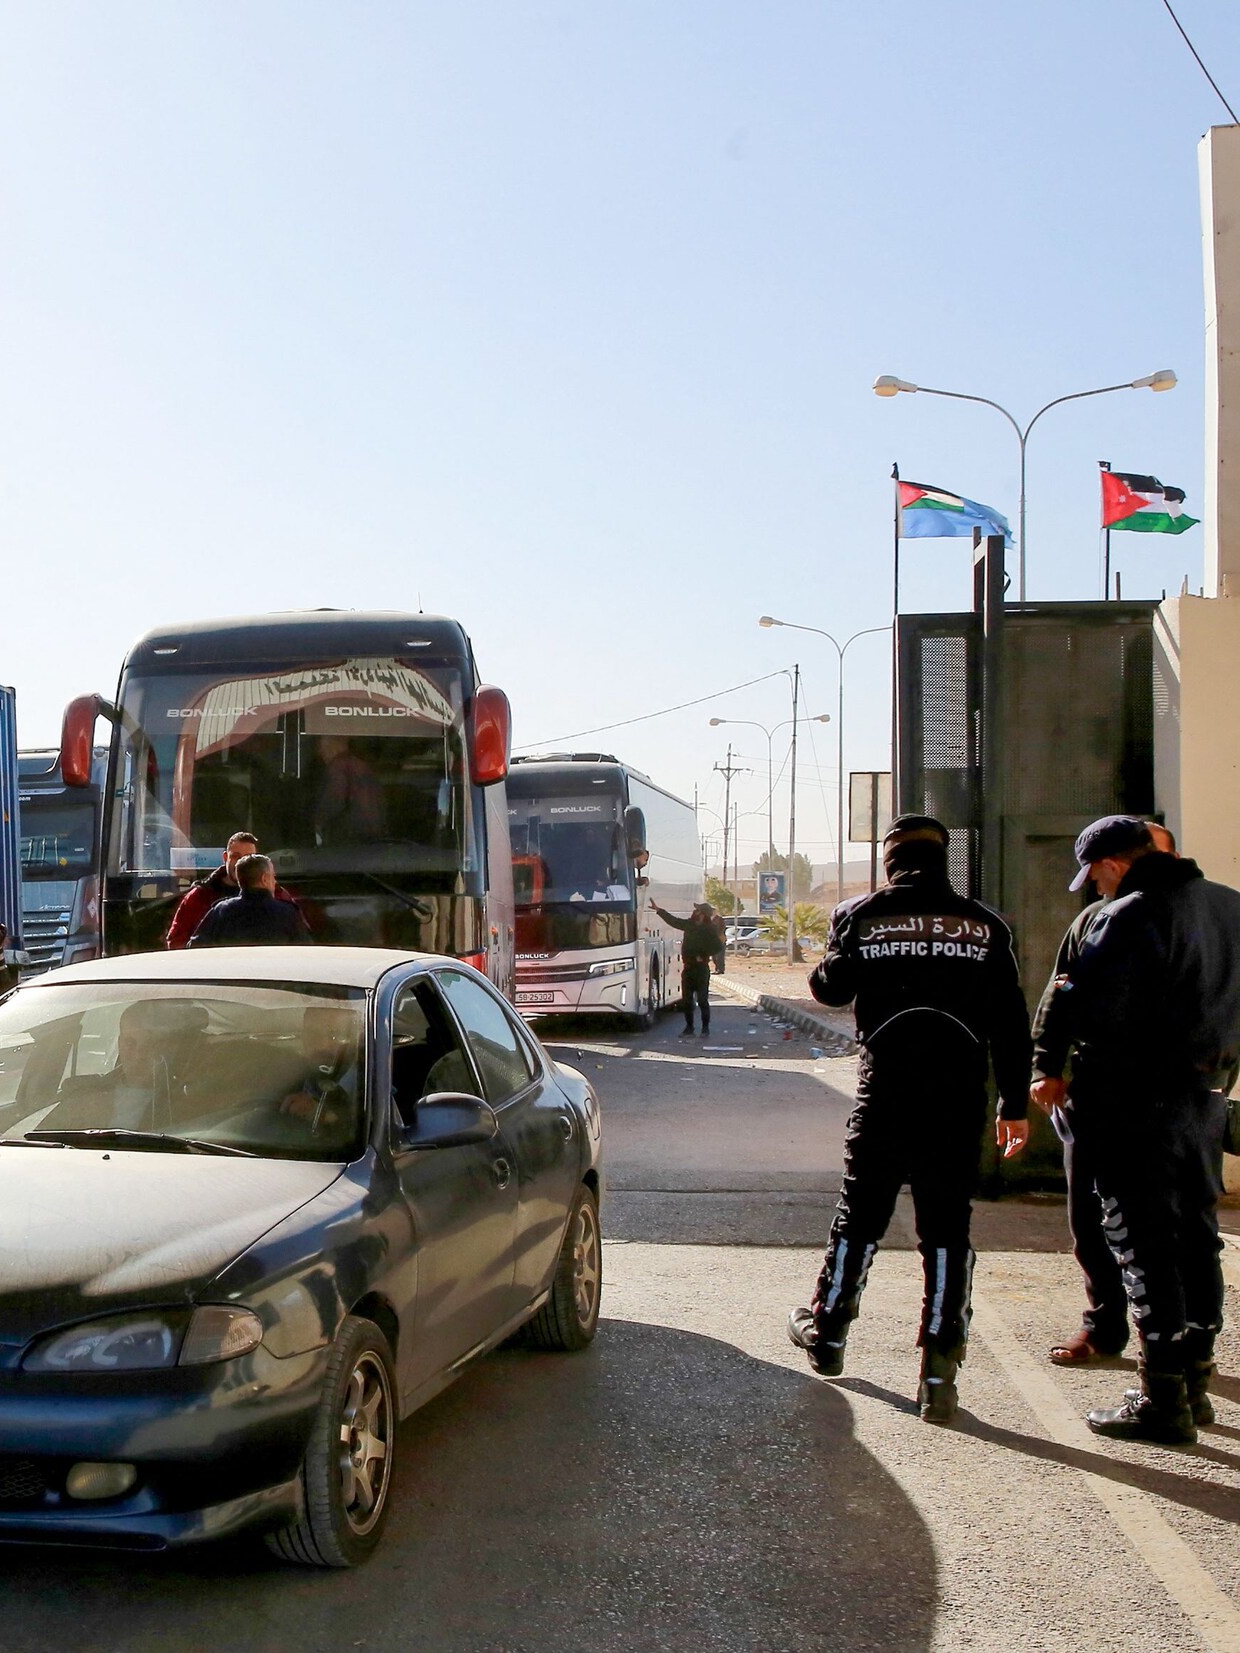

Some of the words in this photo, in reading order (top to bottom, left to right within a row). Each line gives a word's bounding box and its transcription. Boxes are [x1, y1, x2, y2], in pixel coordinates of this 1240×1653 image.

[166, 706, 259, 718] BONLUCK
[325, 706, 421, 717] BONLUCK
[550, 805, 601, 814] BONLUCK
[860, 917, 924, 940] السير
[932, 917, 991, 943] إدارة
[859, 942, 928, 959] TRAFFIC
[932, 942, 989, 961] POLICE
